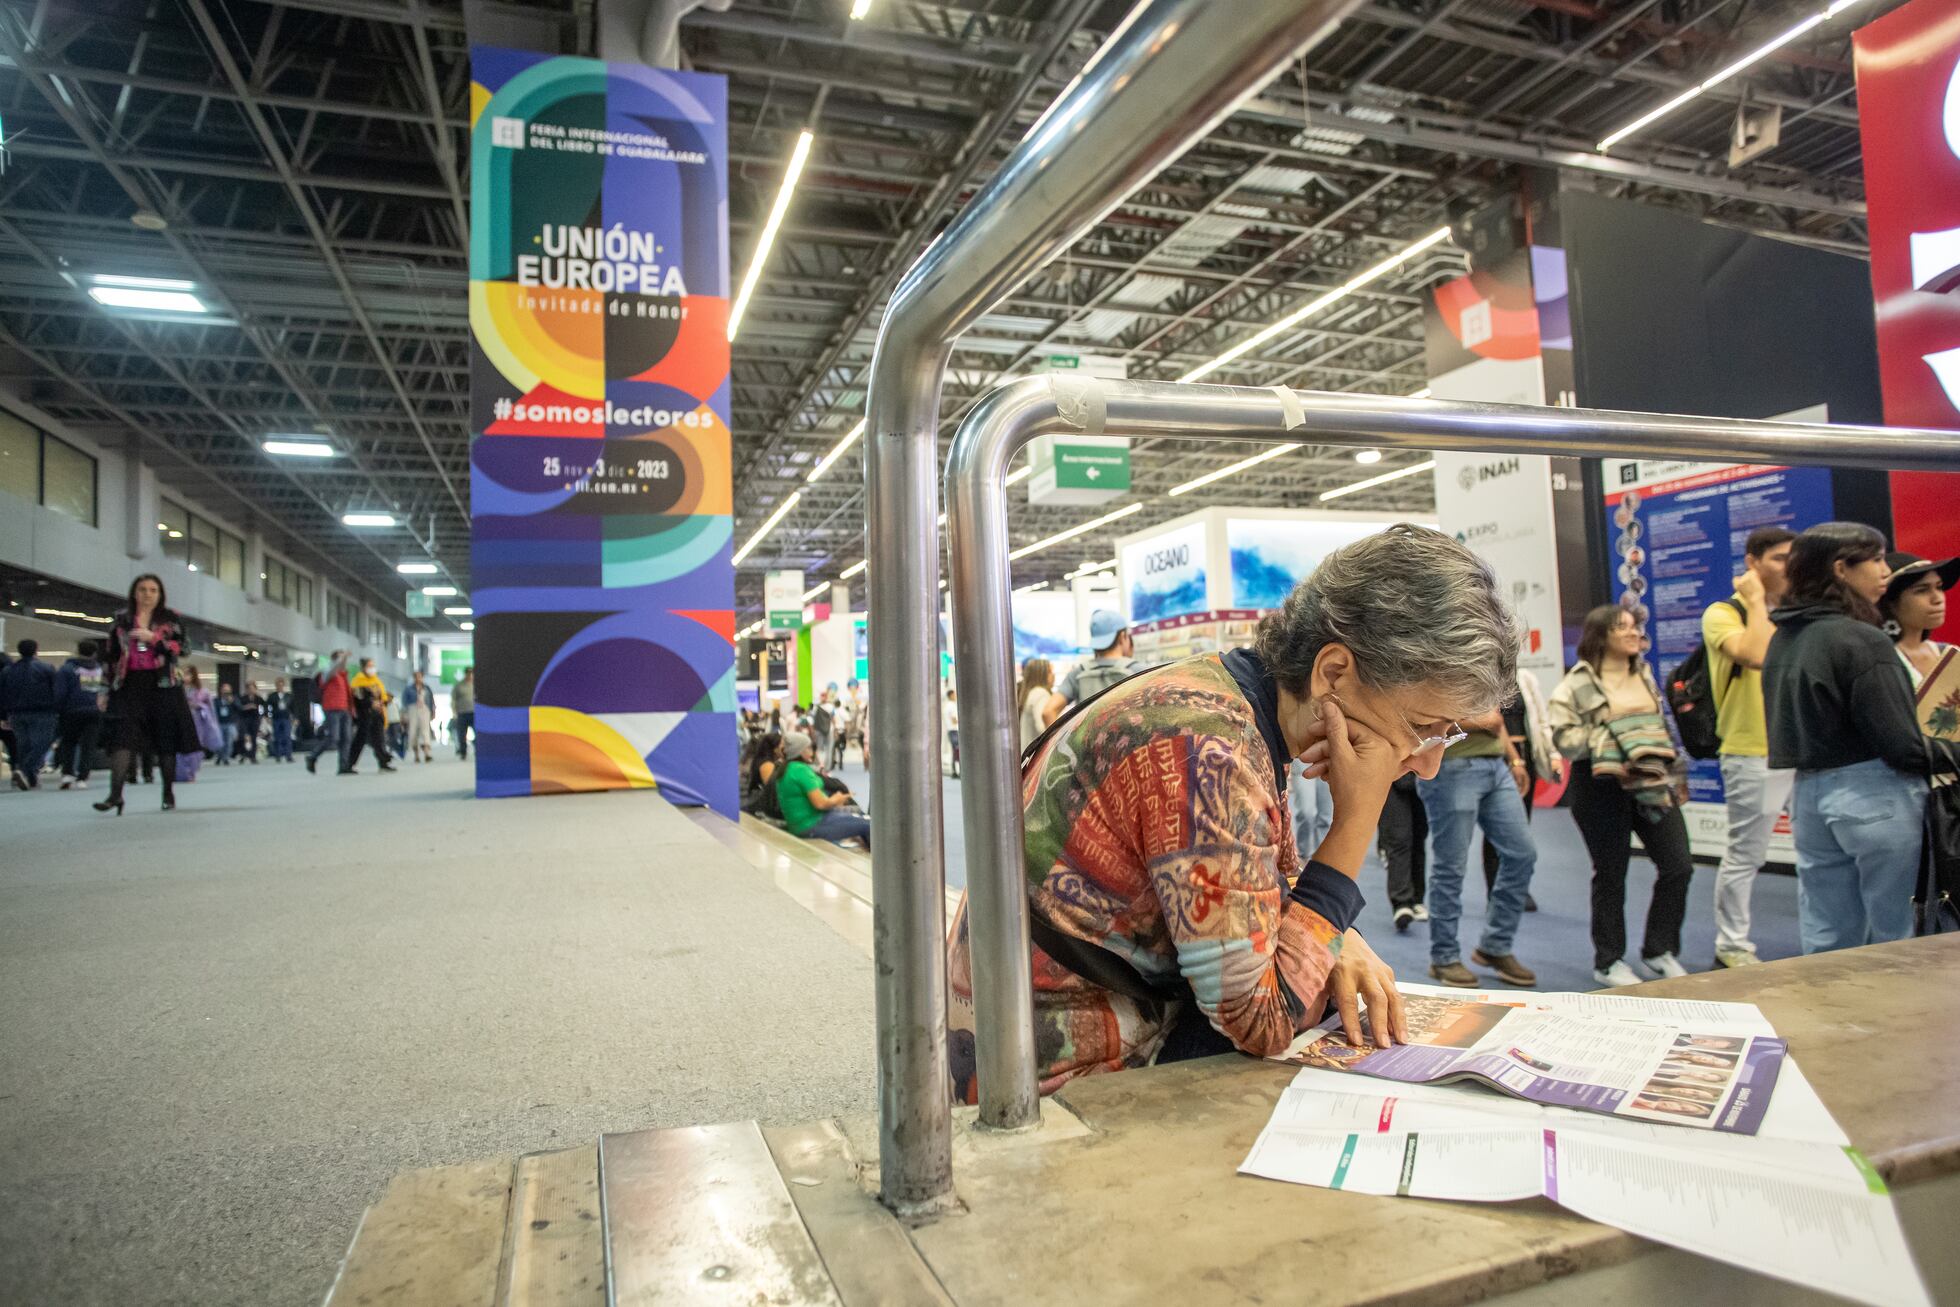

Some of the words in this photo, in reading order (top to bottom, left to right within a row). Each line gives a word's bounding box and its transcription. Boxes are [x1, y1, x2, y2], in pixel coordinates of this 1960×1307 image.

[530, 123, 566, 138] FERIA
[568, 127, 668, 149] INTERNACIONAL
[530, 136, 554, 150] DEL
[557, 138, 595, 153] LIBRO
[597, 142, 615, 156] DE
[616, 144, 706, 165] GUADALAJARA
[542, 222, 656, 263] UNIÓN
[517, 254, 689, 298] EUROPEA
[517, 294, 601, 315] Invitada
[609, 299, 631, 317] de
[636, 301, 689, 320] Honor
[493, 397, 714, 429] #somoslectores
[543, 456, 561, 477] 25
[596, 458, 605, 477] 3
[637, 459, 669, 479] 2023
[1478, 457, 1520, 482] INAH
[1144, 543, 1189, 576] OCEANO
